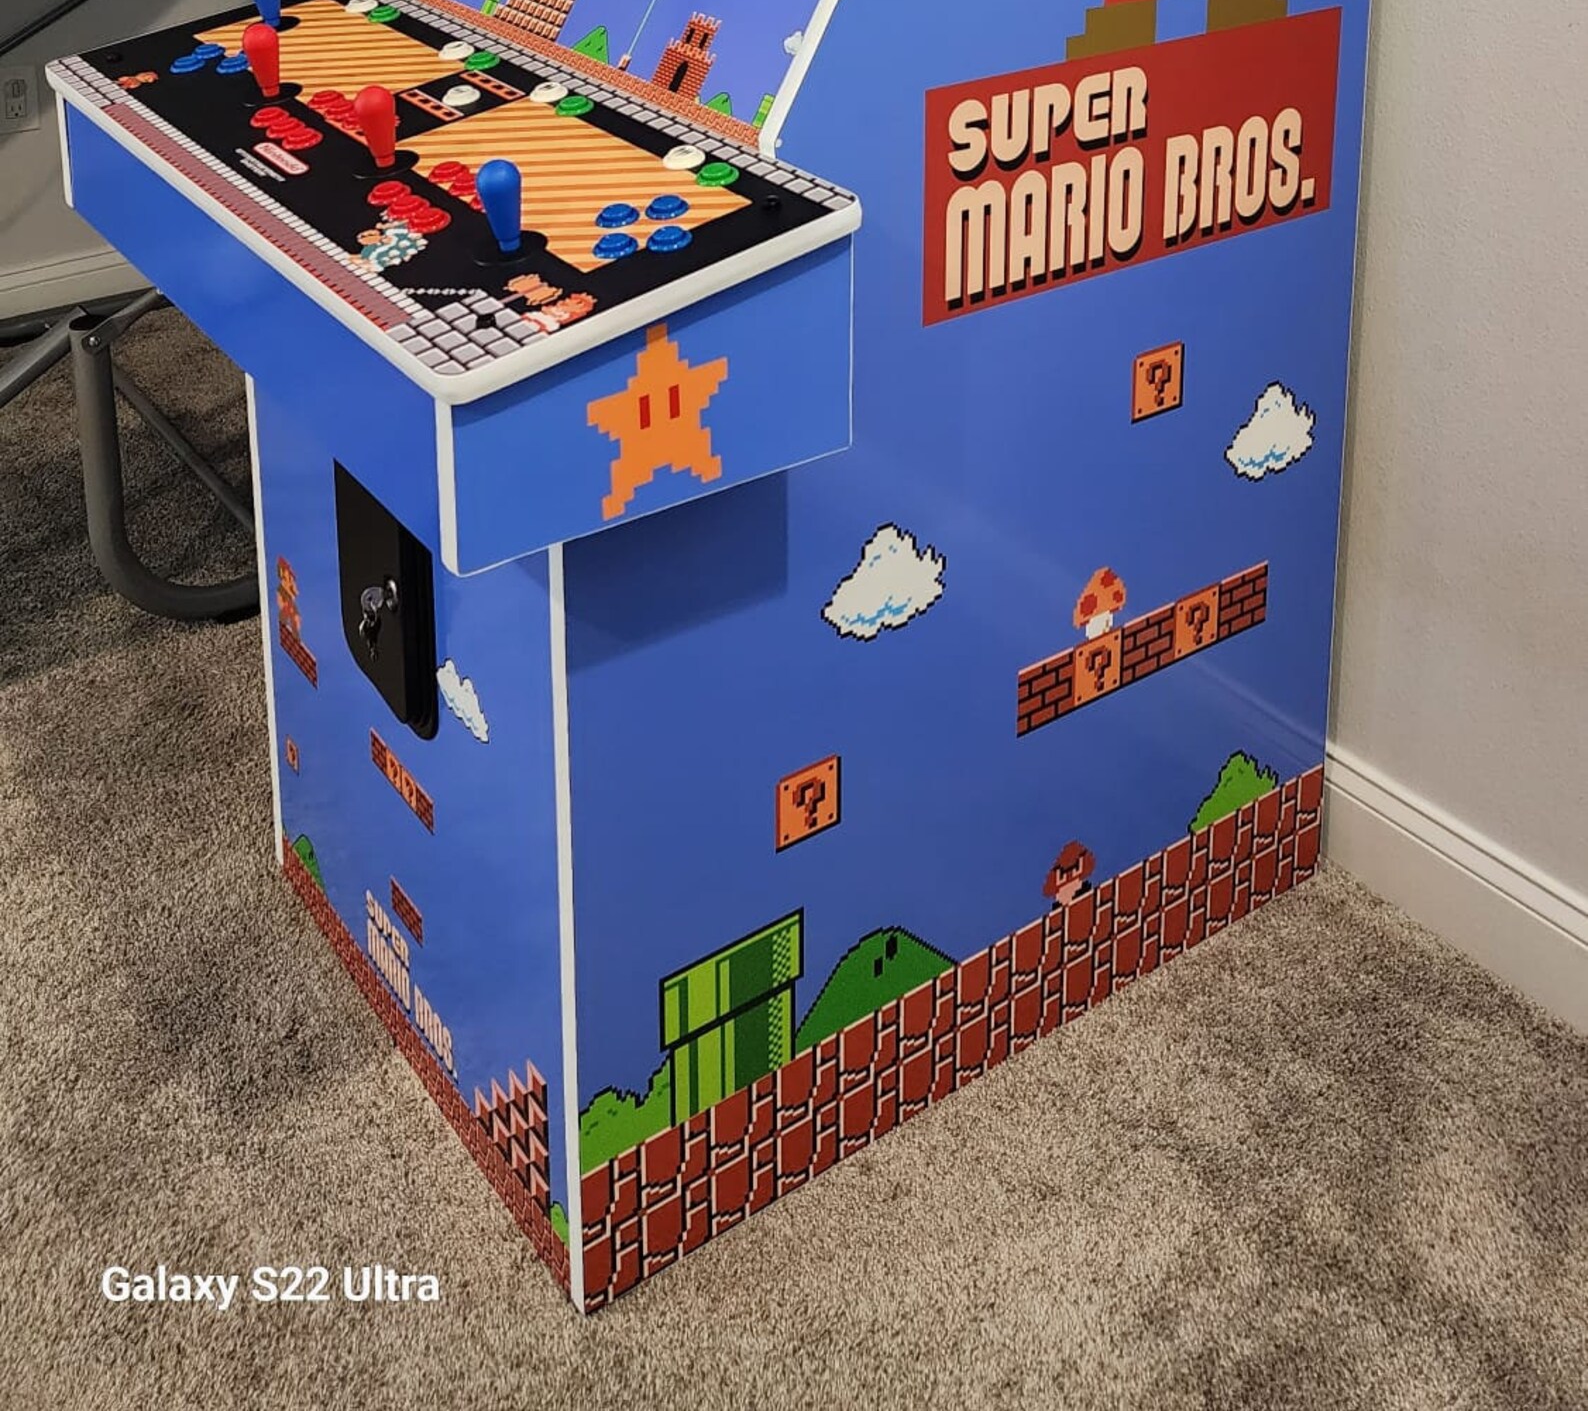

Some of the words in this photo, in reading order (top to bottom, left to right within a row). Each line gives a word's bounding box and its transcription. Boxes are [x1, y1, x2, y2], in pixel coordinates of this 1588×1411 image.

[947, 66, 1148, 180] SUPER
[945, 146, 1144, 310] MARIO
[1163, 107, 1315, 247] BROS.
[365, 890, 409, 967] SUPER
